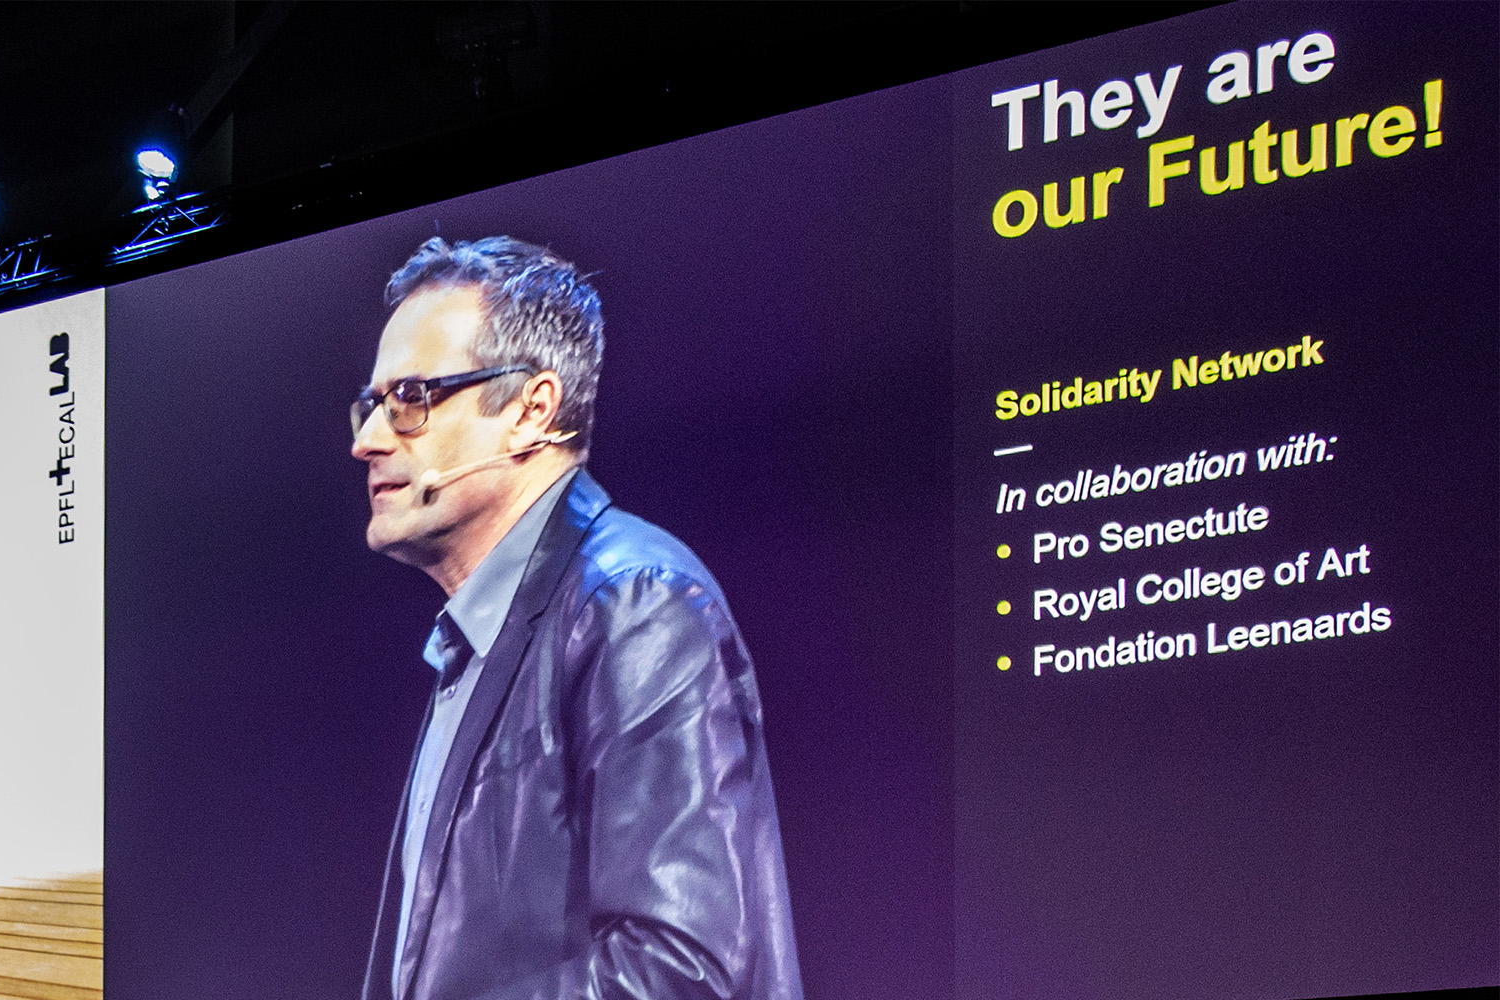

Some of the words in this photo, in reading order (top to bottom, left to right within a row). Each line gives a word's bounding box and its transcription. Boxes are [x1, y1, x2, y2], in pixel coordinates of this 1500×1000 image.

[992, 65, 1183, 151] They
[1207, 31, 1335, 104] are
[992, 167, 1124, 238] our
[1149, 79, 1443, 208] Future!
[996, 367, 1161, 421] Solidarity
[1172, 335, 1324, 390] Network
[996, 483, 1026, 514] In
[1036, 446, 1246, 510] collaboration
[1257, 432, 1338, 472] with:
[1033, 531, 1089, 563] Pro
[1099, 503, 1269, 552] Senectute
[1033, 579, 1125, 621] Royal
[1136, 564, 1265, 608] College
[1274, 552, 1310, 585] of
[1316, 543, 1370, 578] Art
[1033, 633, 1197, 677] Fondation
[1206, 601, 1392, 655] Leenaards
